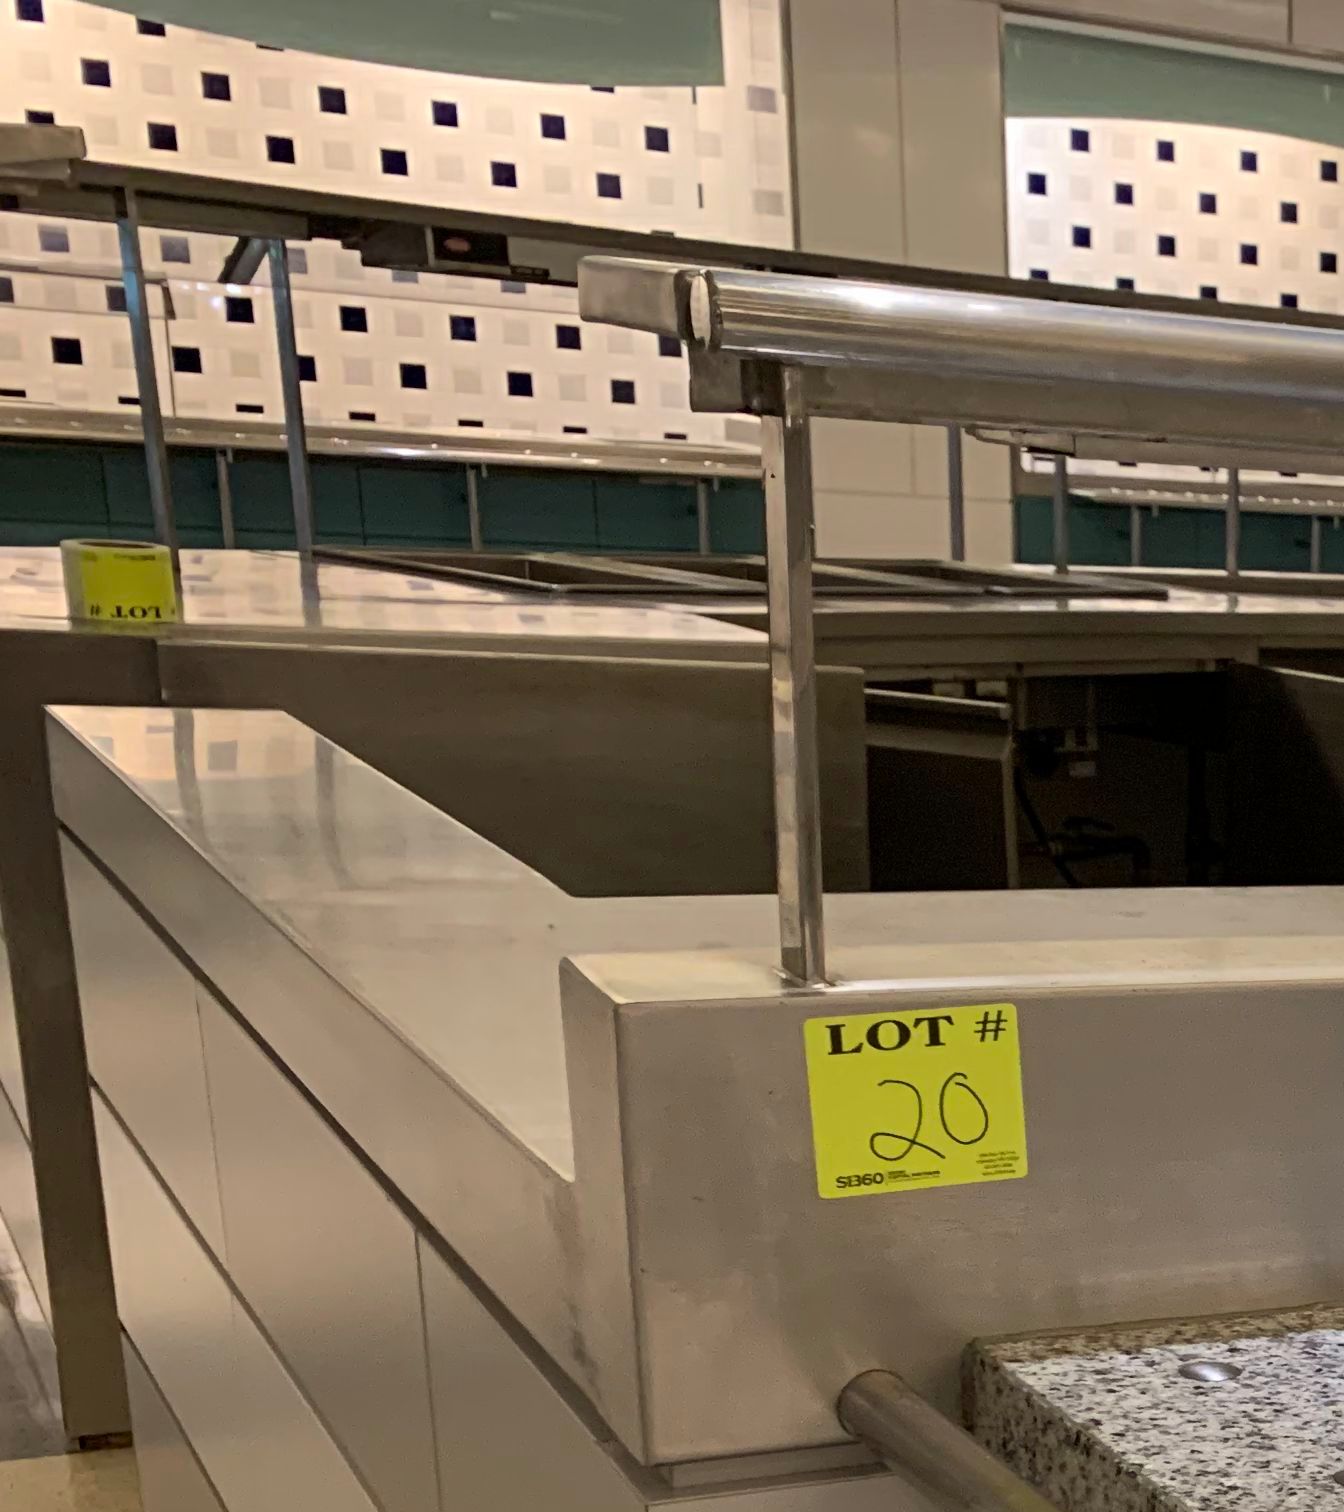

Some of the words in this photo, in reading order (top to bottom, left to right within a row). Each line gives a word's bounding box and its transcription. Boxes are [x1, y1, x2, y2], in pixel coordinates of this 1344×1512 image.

[111, 605, 162, 619] LOT
[825, 1015, 954, 1055] LOT
[974, 1010, 1008, 1042] #
[869, 1072, 989, 1161] 20
